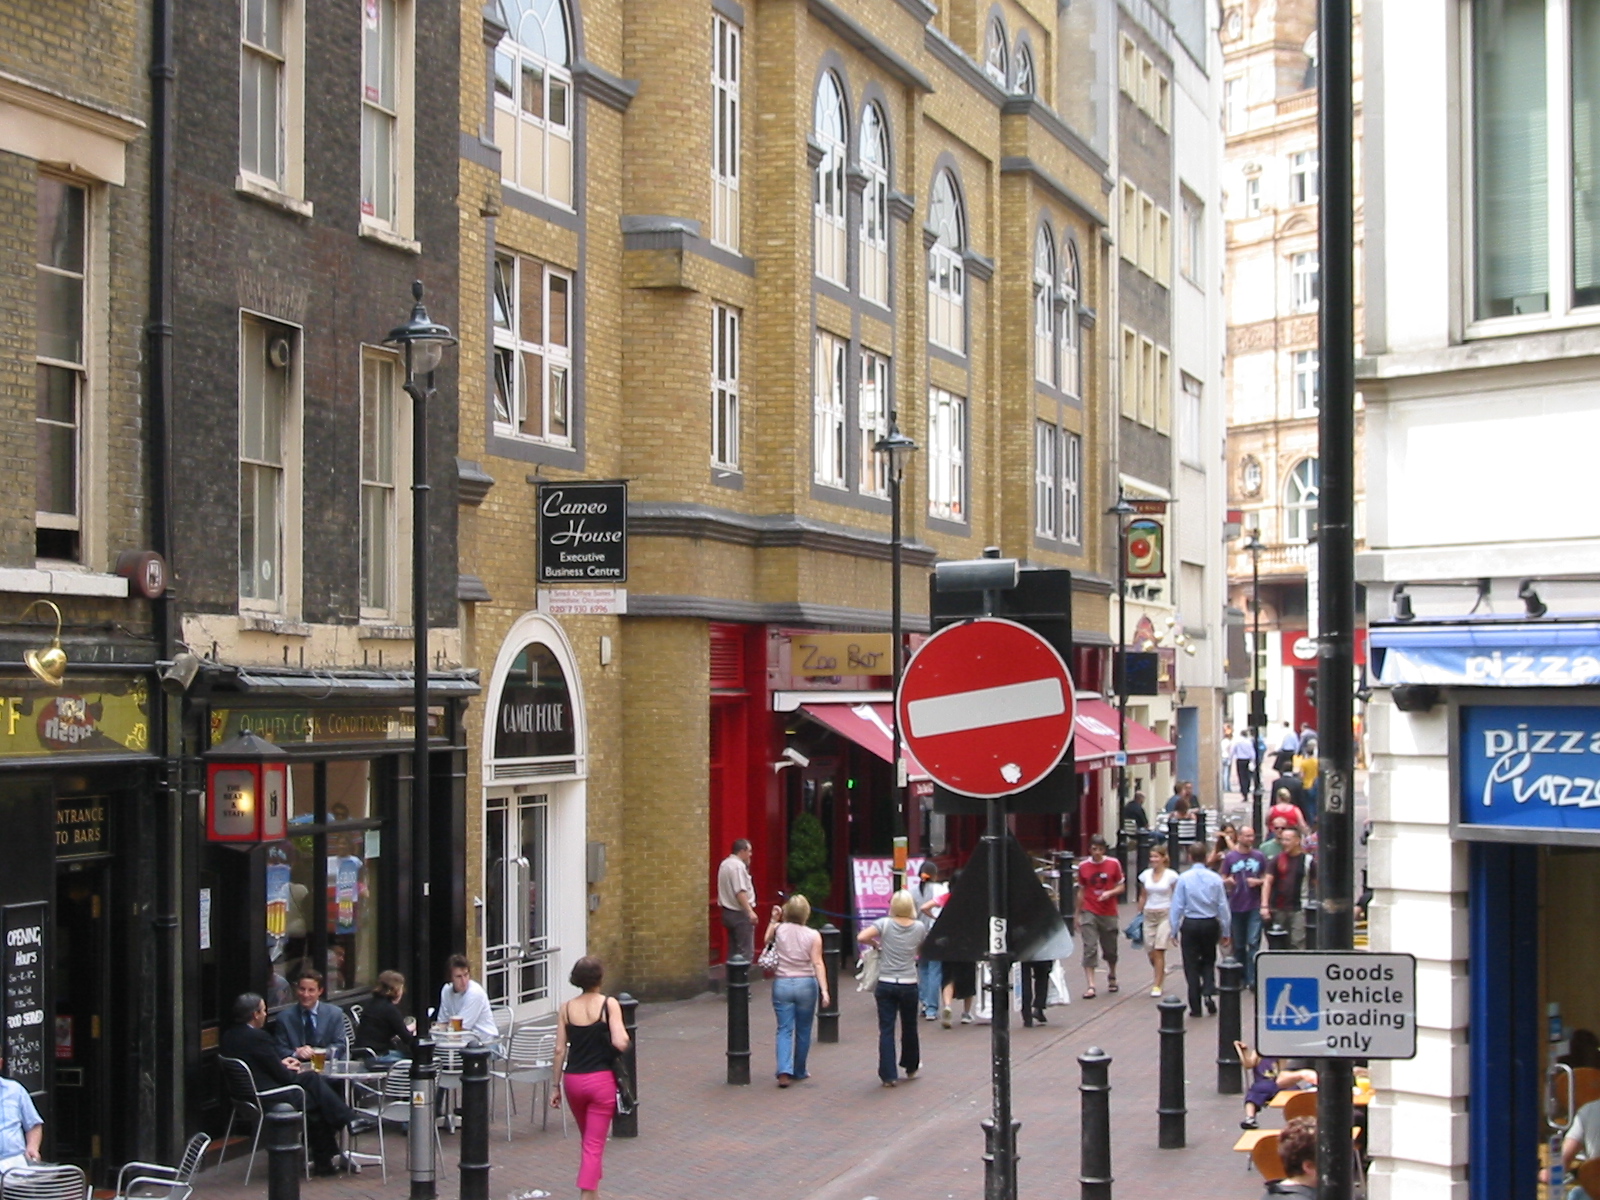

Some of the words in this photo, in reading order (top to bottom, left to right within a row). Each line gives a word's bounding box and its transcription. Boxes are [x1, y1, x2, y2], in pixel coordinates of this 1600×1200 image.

[542, 490, 608, 517] Cameo
[550, 518, 622, 547] House
[559, 552, 606, 563] Executive
[545, 567, 584, 577] Business
[587, 565, 620, 576] Centre
[799, 644, 837, 670] Zoo
[847, 643, 884, 669] Bar
[1465, 650, 1600, 682] pizza
[328, 713, 394, 734] CONDITIONED
[503, 703, 534, 733] CAMEO
[536, 703, 563, 732] HOUSE
[1483, 749, 1600, 808] Piazz
[56, 808, 104, 824] NTRANCE
[55, 831, 69, 845] TO
[74, 828, 101, 843] BARS
[7, 926, 41, 947] OPENING
[1326, 963, 1394, 981] Goods
[1326, 986, 1404, 1004] vehicle
[1326, 1009, 1405, 1029] loading
[1326, 1032, 1372, 1052] only
